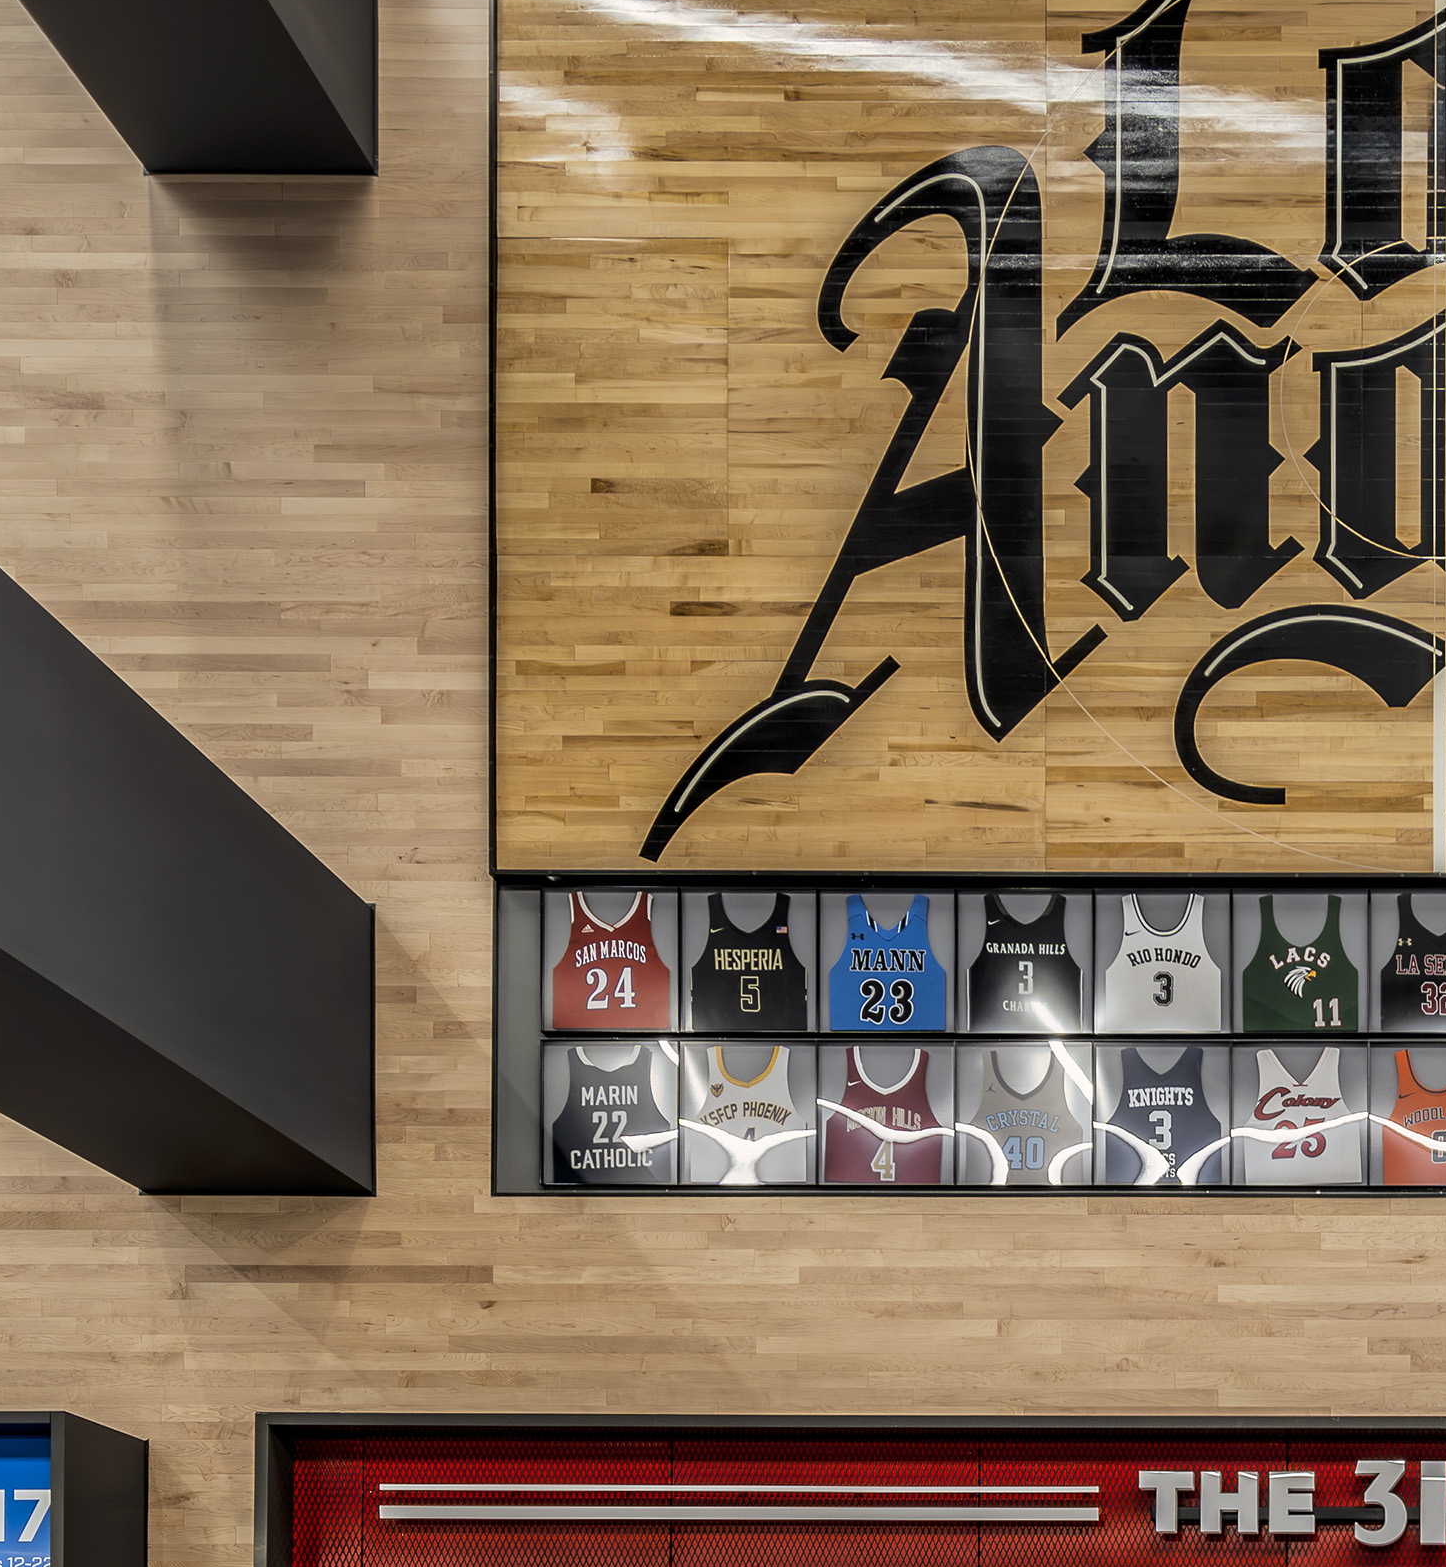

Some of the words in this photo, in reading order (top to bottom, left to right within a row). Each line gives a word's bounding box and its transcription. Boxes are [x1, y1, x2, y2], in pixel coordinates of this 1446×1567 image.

[574, 943, 596, 967] SAN
[599, 940, 647, 966] MARCOS
[713, 948, 782, 972] HESPERIA
[985, 942, 1034, 955] GRANADA
[1038, 941, 1066, 956] HILLS
[1126, 949, 1151, 968] RIO
[1154, 948, 1201, 969] HONDO
[1269, 947, 1332, 970] LACS
[850, 949, 927, 972] MANN
[1396, 954, 1419, 976] LA
[585, 967, 637, 1010] 24
[859, 978, 915, 1024] 23
[581, 1085, 638, 1105] MARIN
[1127, 1087, 1194, 1108] KNIGHTS
[985, 1108, 1060, 1134] CRYSTAL
[569, 1149, 653, 1169] CATHOLIC
[1138, 1471, 1316, 1535] THE
